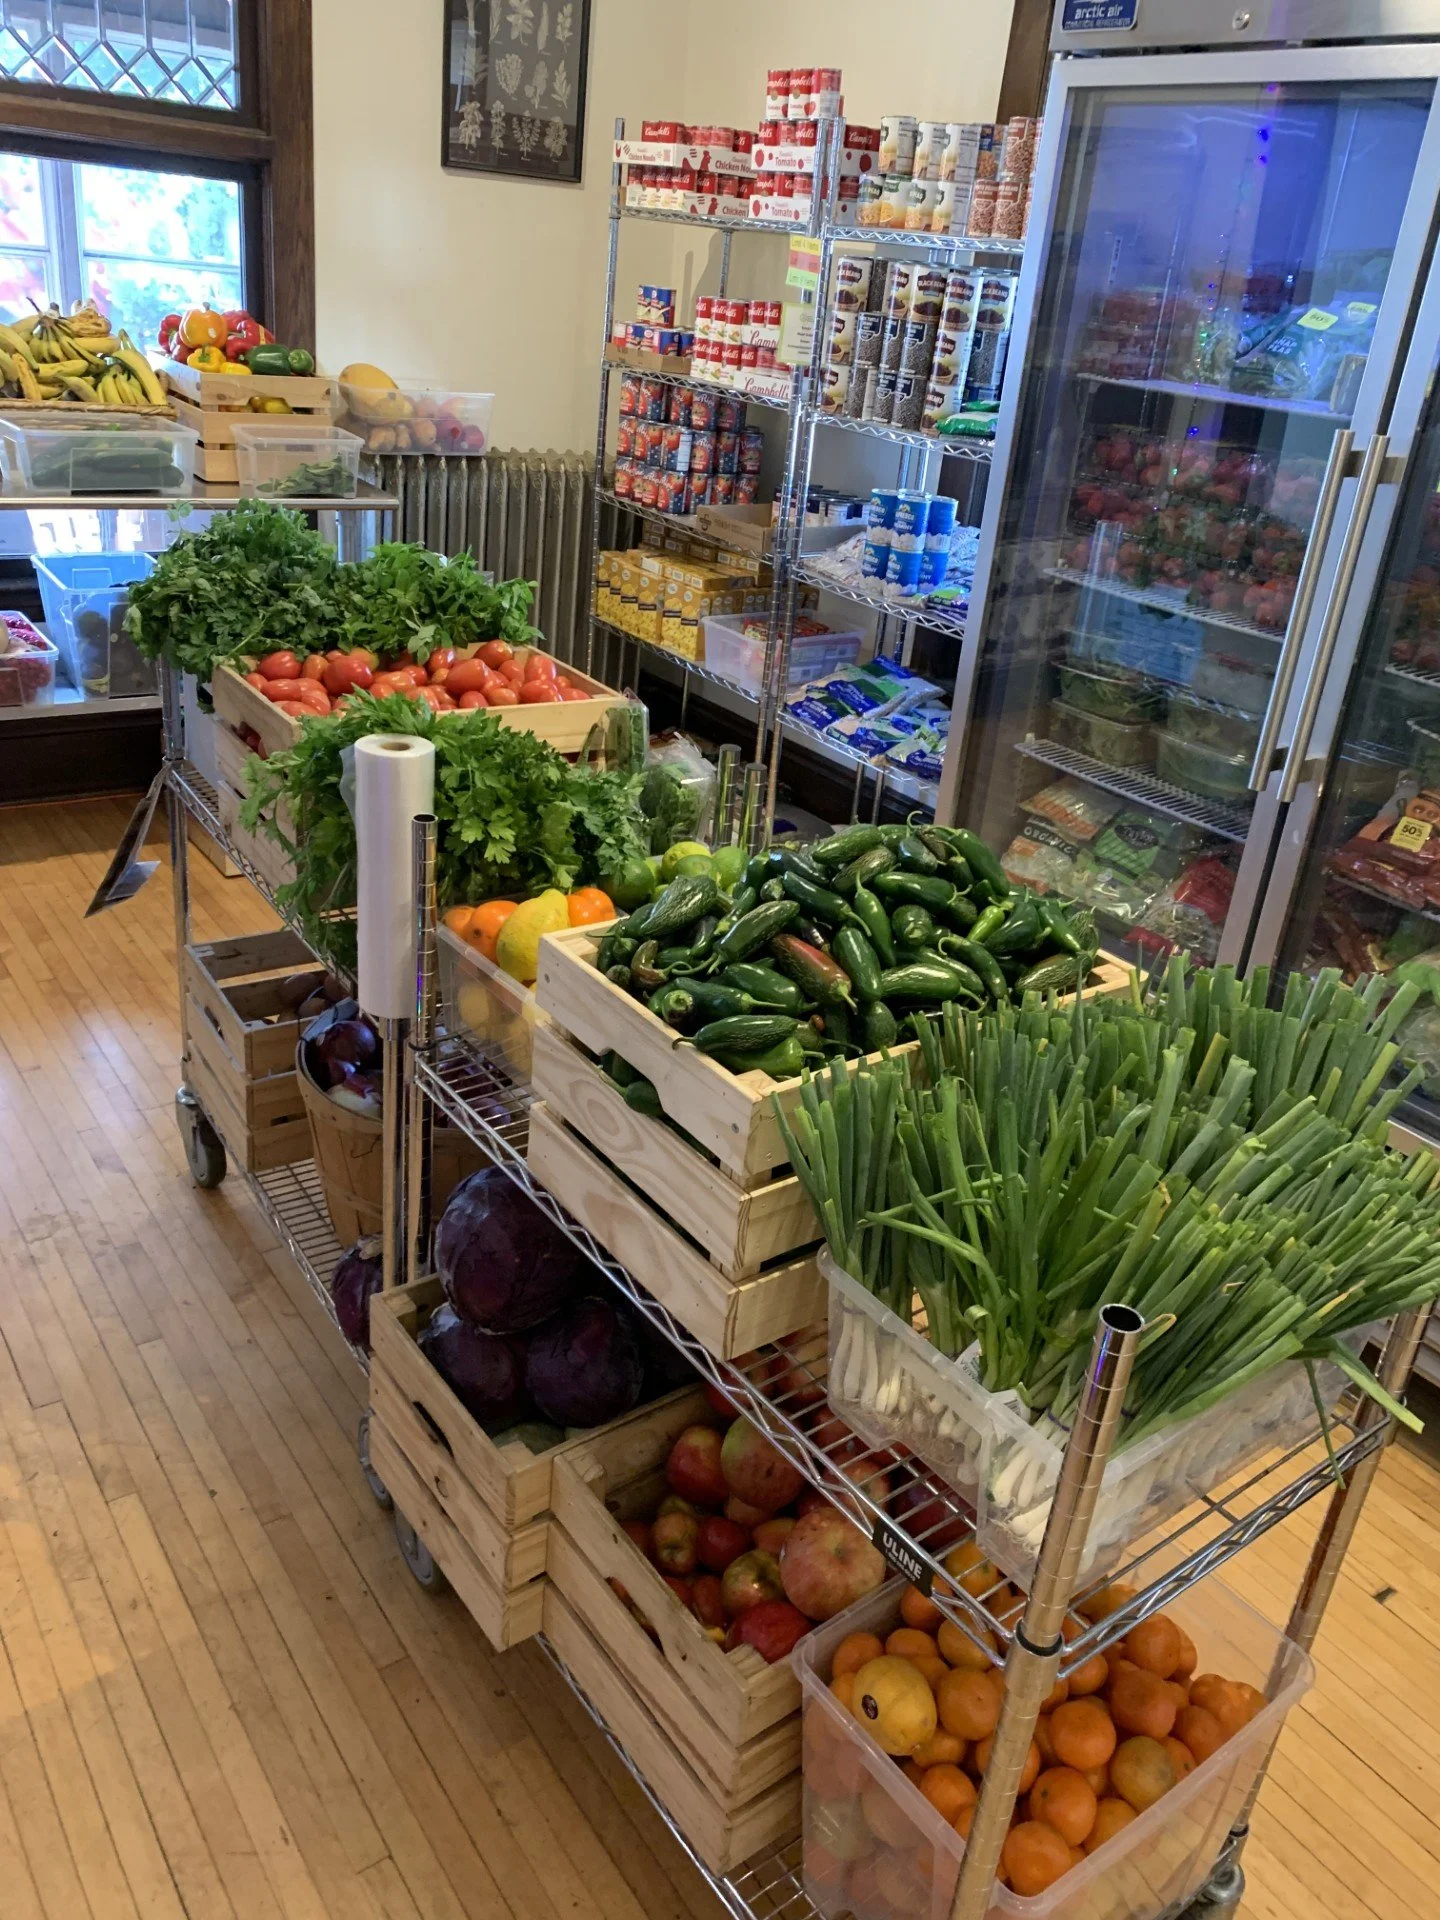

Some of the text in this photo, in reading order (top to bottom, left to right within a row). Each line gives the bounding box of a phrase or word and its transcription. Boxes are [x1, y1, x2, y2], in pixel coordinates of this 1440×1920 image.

[1074, 4, 1124, 20] arctic air
[715, 160, 740, 171] Chicken
[775, 156, 796, 168] Tomato
[722, 206, 746, 217] Chicken
[771, 206, 793, 218] Tomato
[1023, 826, 1077, 855] ORGANIC
[882, 1531, 923, 1580] ULINE
